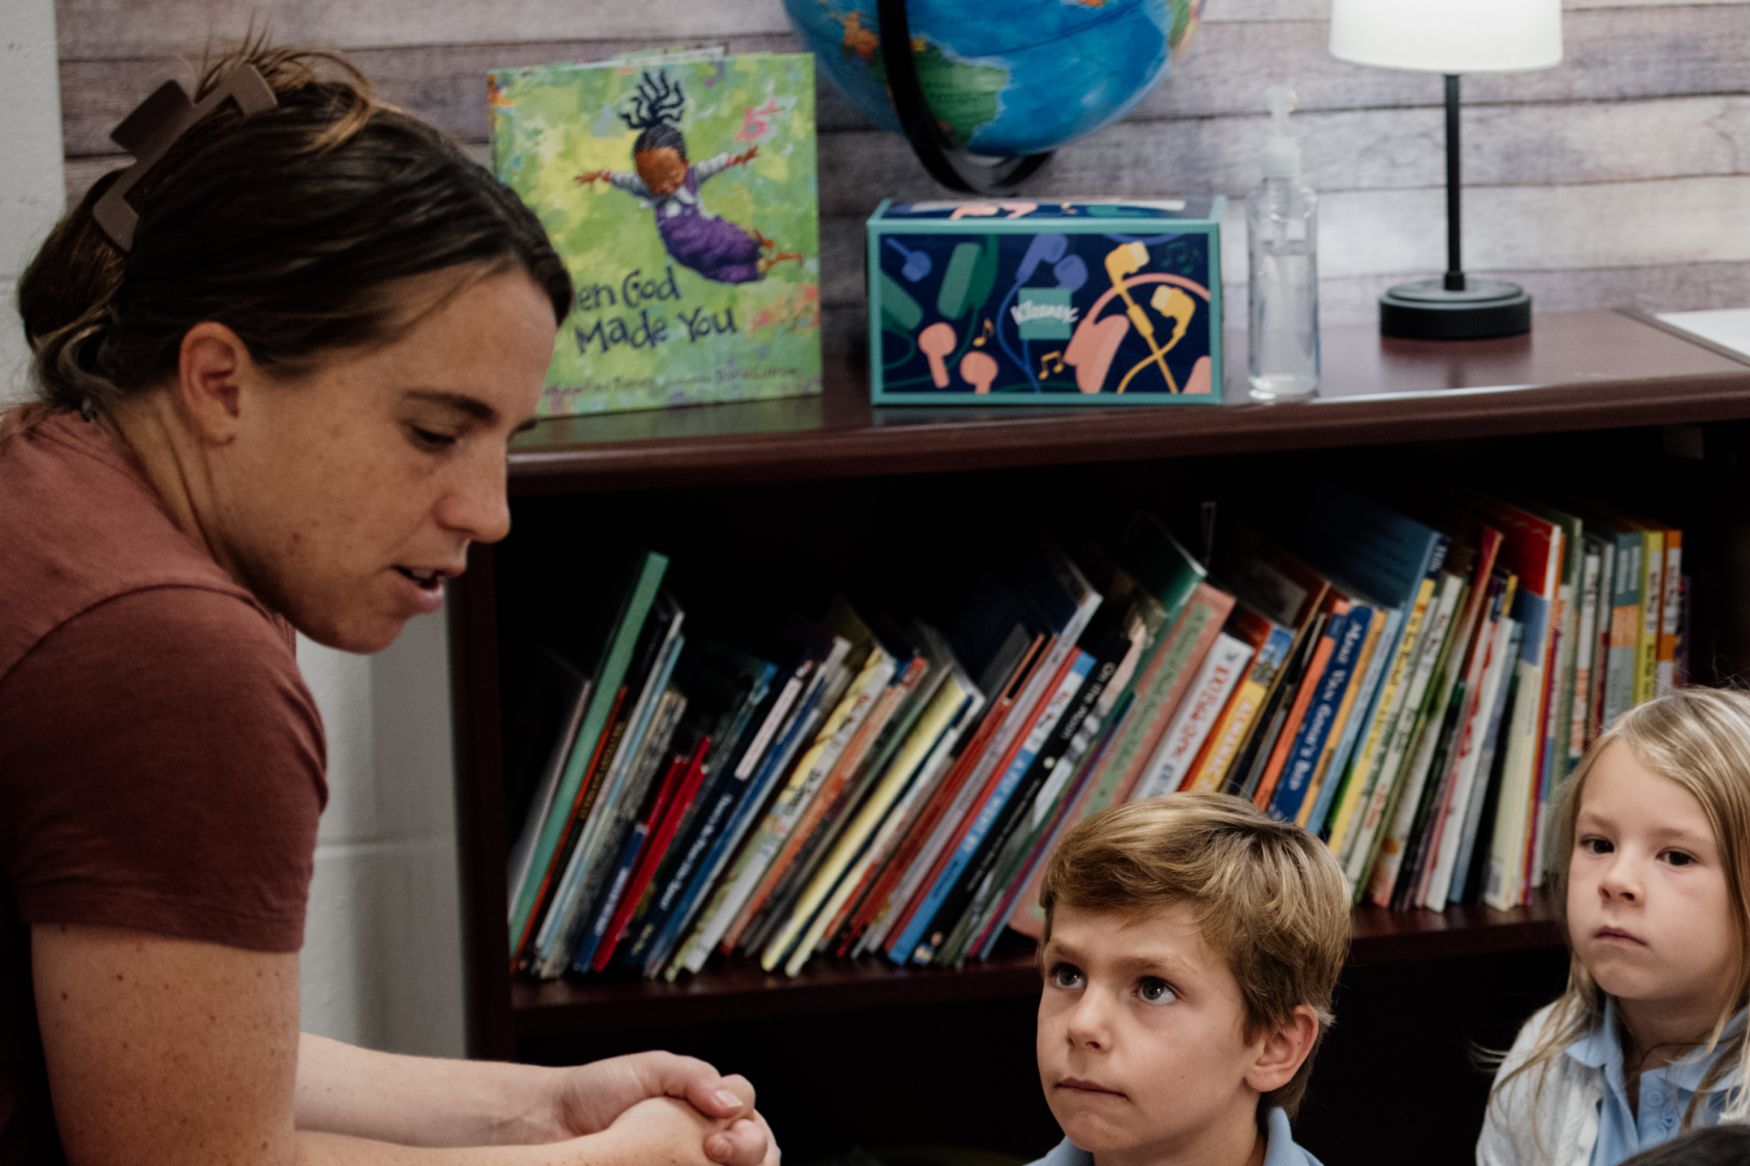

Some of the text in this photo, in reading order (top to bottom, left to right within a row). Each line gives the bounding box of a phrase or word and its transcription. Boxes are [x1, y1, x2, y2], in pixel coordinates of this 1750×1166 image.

[573, 266, 681, 311] en God
[575, 306, 738, 354] Made You
[1060, 659, 1116, 740] On the Moon
